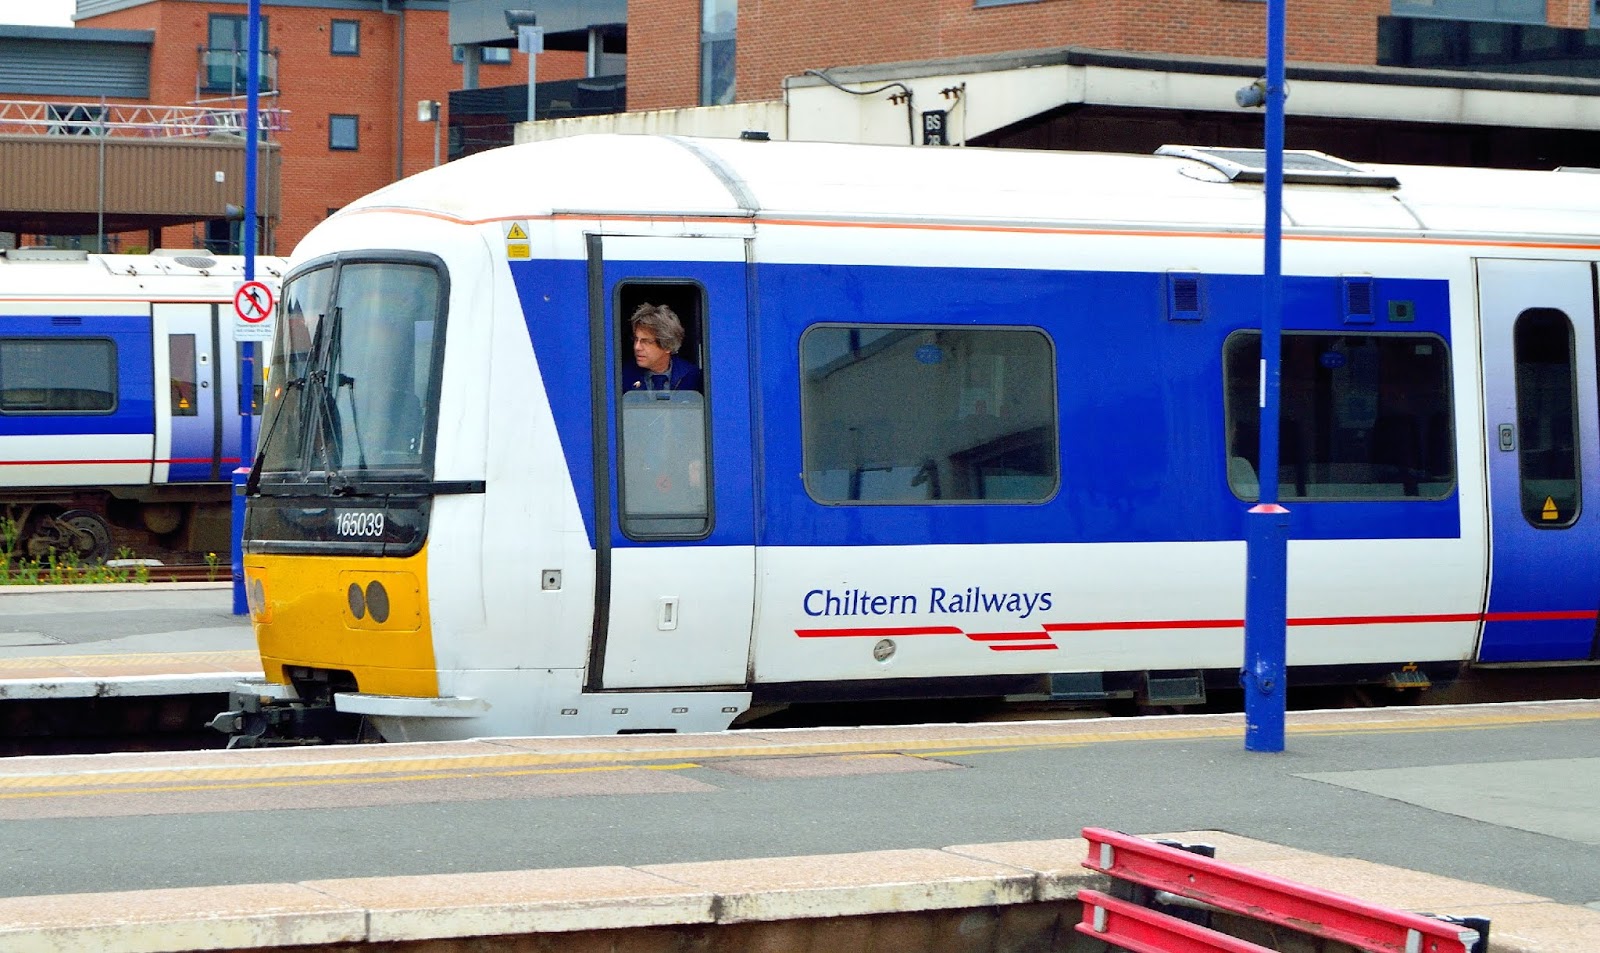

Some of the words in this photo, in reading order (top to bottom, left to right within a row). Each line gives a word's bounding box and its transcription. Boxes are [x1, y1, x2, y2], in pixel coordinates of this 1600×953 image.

[926, 114, 941, 130] BS
[337, 512, 385, 537] 165039
[803, 588, 918, 617] Chiltern
[928, 587, 1053, 619] Railways
